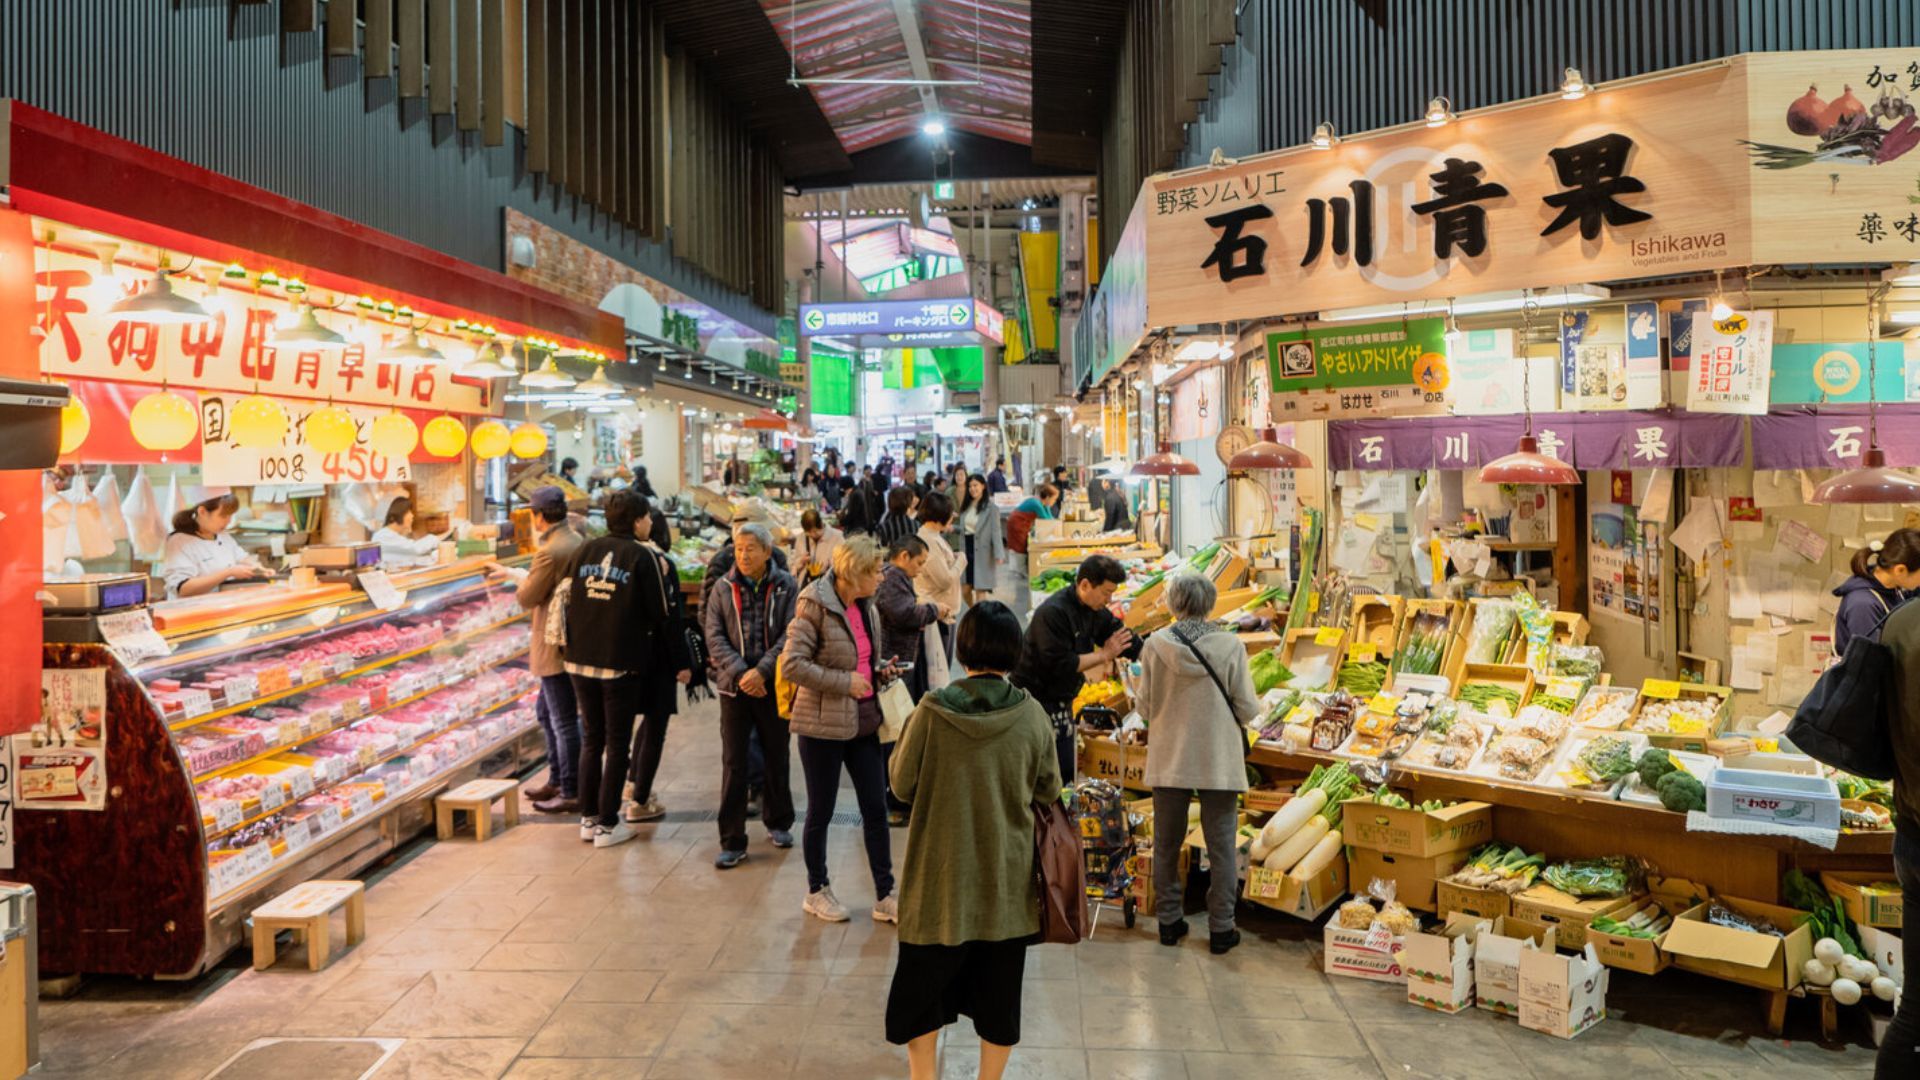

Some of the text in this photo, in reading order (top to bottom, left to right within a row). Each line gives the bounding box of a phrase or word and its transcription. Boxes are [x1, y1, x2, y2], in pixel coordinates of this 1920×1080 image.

[1156, 170, 1286, 216] 野菜ソムリエ
[1201, 132, 1653, 283] 石川青果
[1631, 232, 1726, 257] Ishikawa
[1632, 248, 1727, 267] Vegetables and Fruits
[1732, 335, 1747, 375] クール
[1828, 425, 1865, 459] 石
